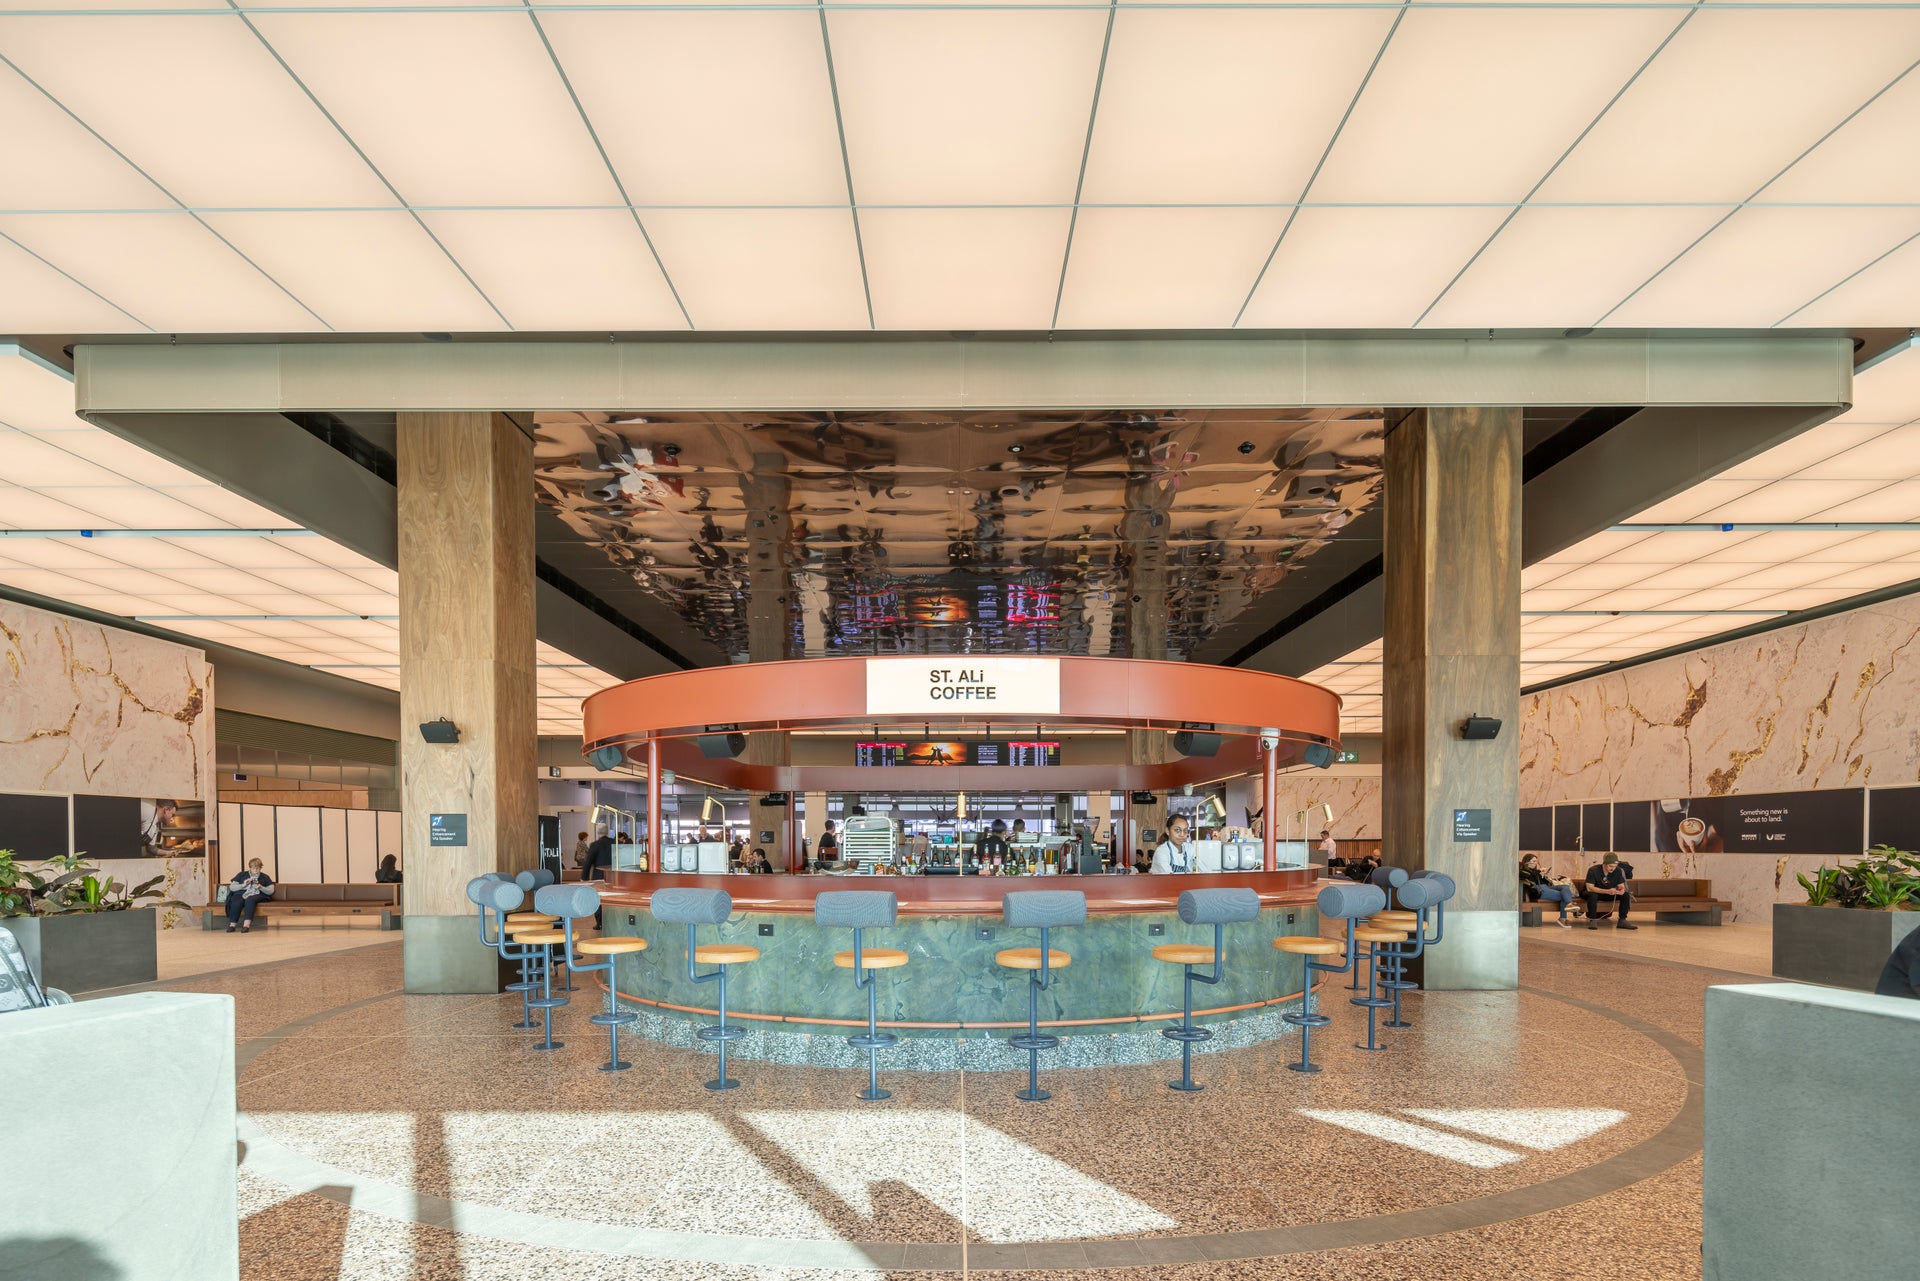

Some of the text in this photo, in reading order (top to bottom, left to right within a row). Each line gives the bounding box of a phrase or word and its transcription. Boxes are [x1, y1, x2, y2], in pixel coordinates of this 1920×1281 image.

[930, 670, 983, 683] ST. ALi
[930, 687, 996, 700] COFFEE
